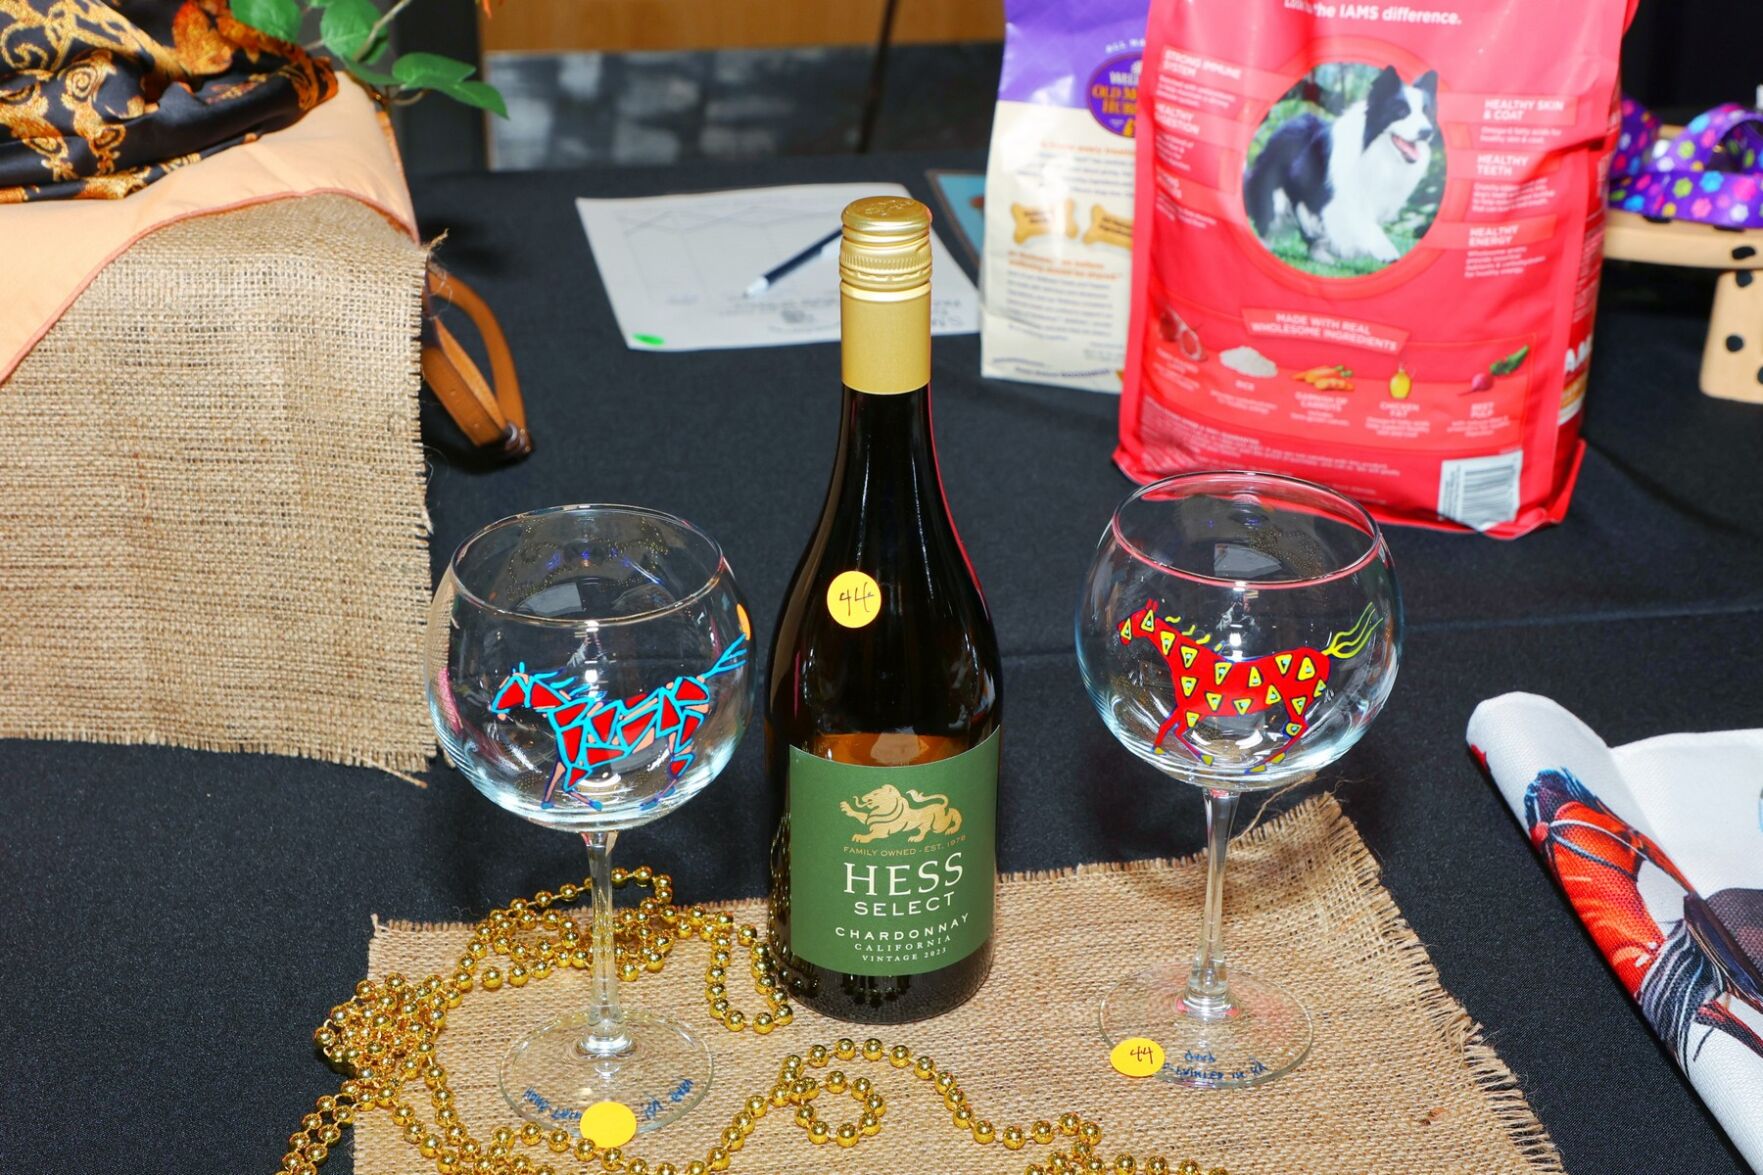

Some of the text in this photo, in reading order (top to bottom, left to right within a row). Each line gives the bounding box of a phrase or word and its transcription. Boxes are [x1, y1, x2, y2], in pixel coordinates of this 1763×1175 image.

[1339, 4, 1379, 20] IAMS
[1382, 6, 1461, 25] difference.
[1484, 99, 1565, 112] HEALTHY SKIN
[1493, 110, 1525, 121] COAT
[1477, 154, 1528, 166] HEALTHY
[1477, 165, 1512, 176] TEETH
[1469, 225, 1519, 238] HEALTHY
[1468, 235, 1513, 247] ENERGY
[1276, 313, 1372, 335] MADE WITH REAL
[1251, 322, 1398, 351] WHOLESOME INGREDIENTS
[843, 846, 878, 857] FAMILY
[880, 848, 917, 857] OWNED
[924, 842, 944, 853] EST.
[843, 852, 964, 896] HESS
[854, 891, 955, 917] SELECT
[835, 913, 969, 941] CHARDONNAY
[854, 935, 951, 952] CALIFORNIA
[862, 953, 918, 962] VINTAGE
